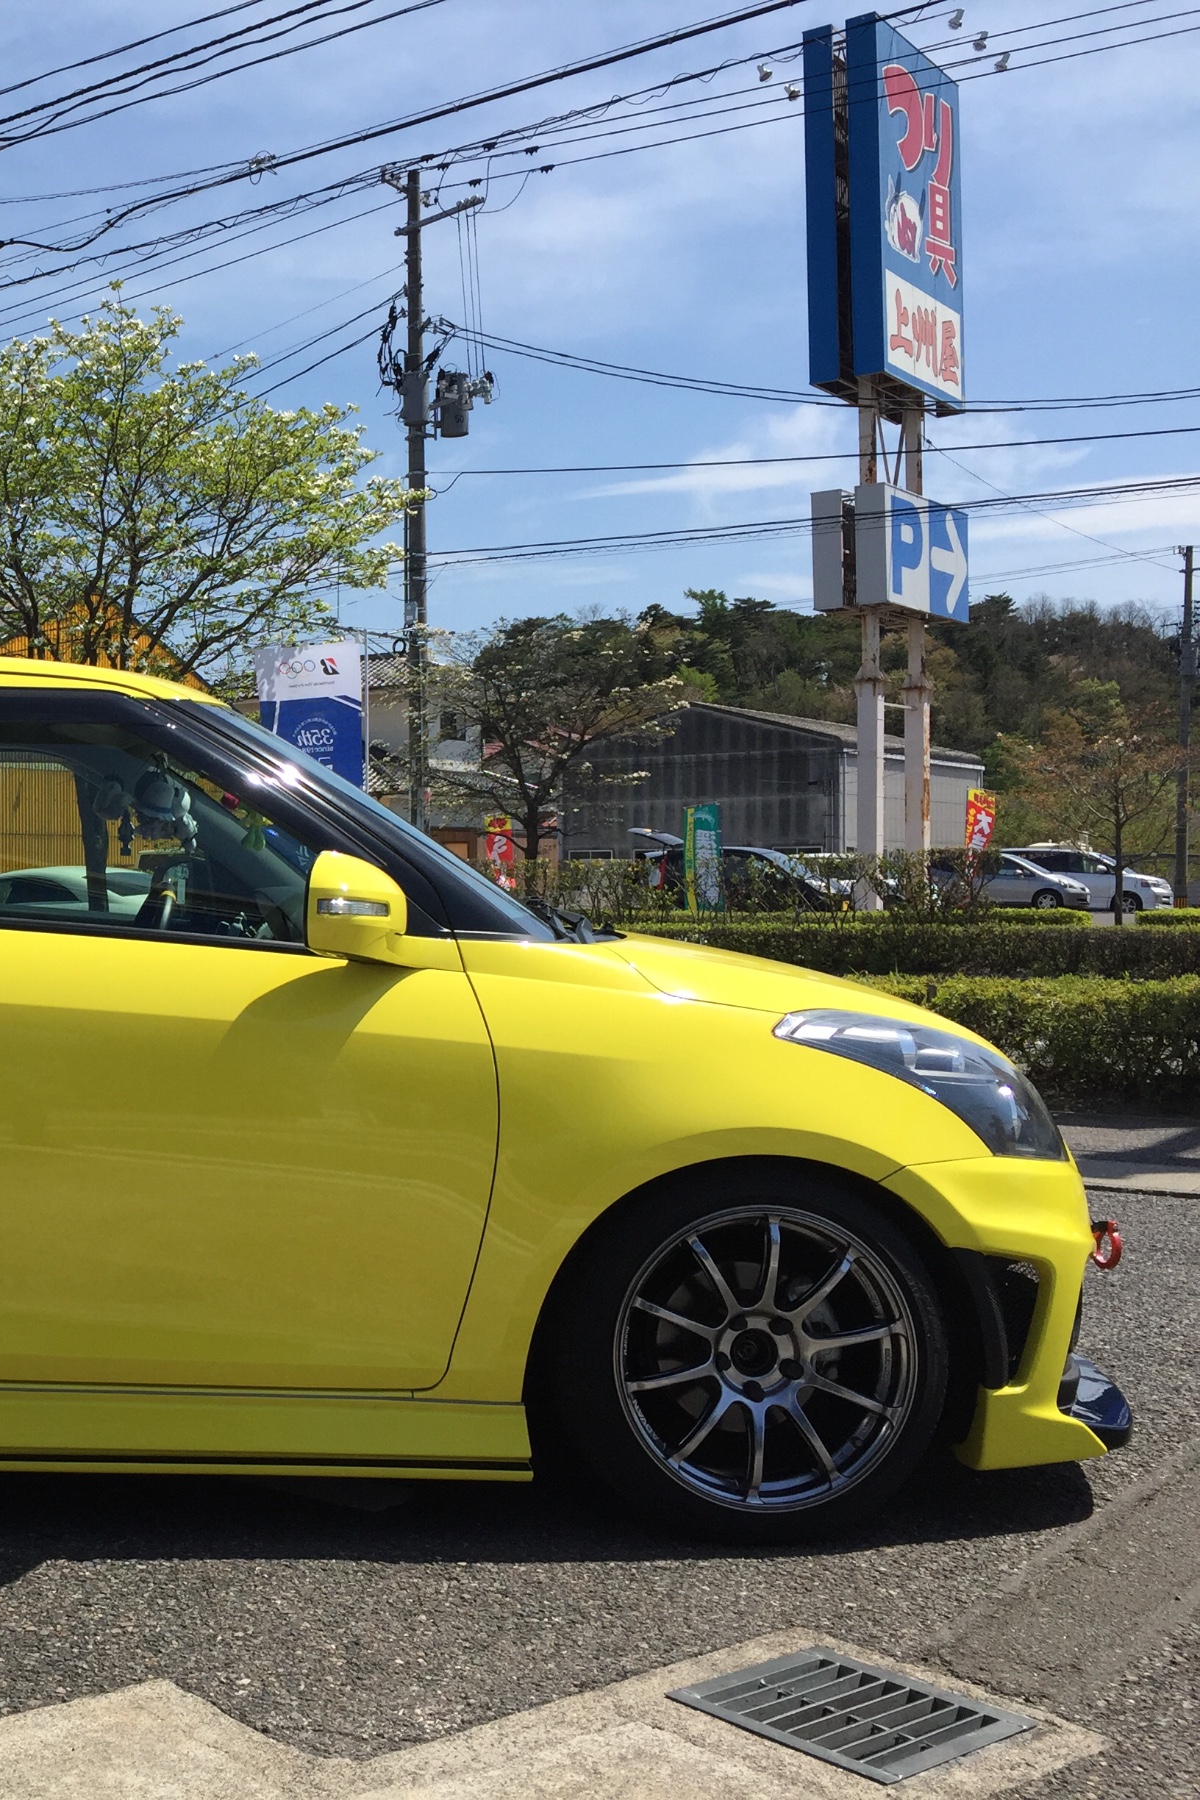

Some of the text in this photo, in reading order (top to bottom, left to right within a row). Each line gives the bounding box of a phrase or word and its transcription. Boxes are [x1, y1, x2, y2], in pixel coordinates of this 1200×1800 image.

[882, 64, 957, 289] つり具
[889, 288, 960, 387] 上州屋
[891, 495, 923, 595] P
